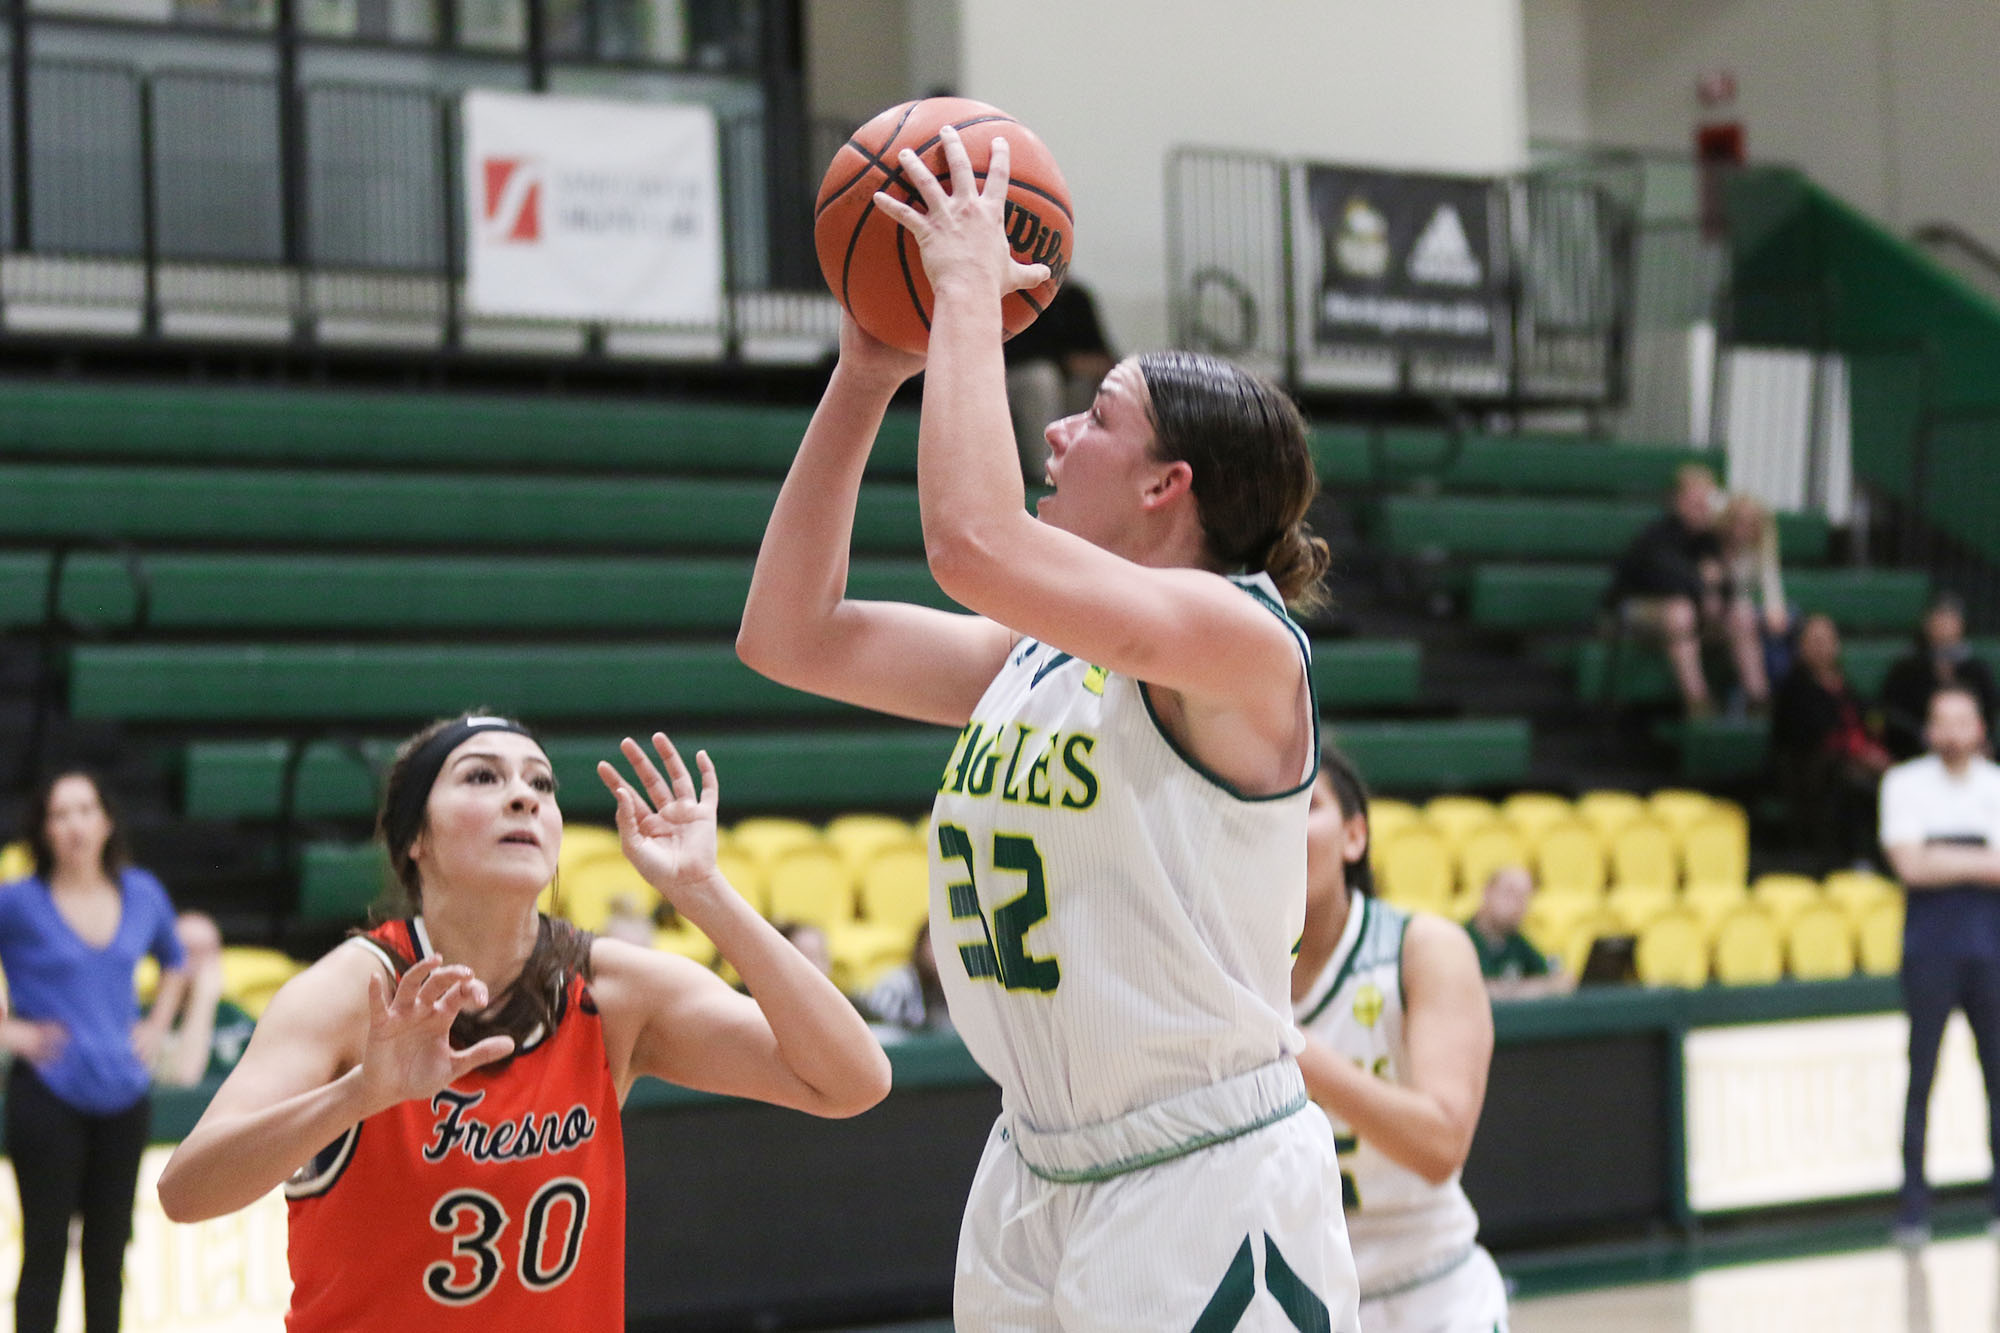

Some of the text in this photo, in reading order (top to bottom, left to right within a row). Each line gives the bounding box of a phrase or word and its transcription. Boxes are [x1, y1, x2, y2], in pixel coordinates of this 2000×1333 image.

[938, 720, 1100, 811] AGLES
[937, 822, 1061, 995] 32
[422, 1089, 597, 1163] Fresno
[422, 1176, 591, 1307] 30
